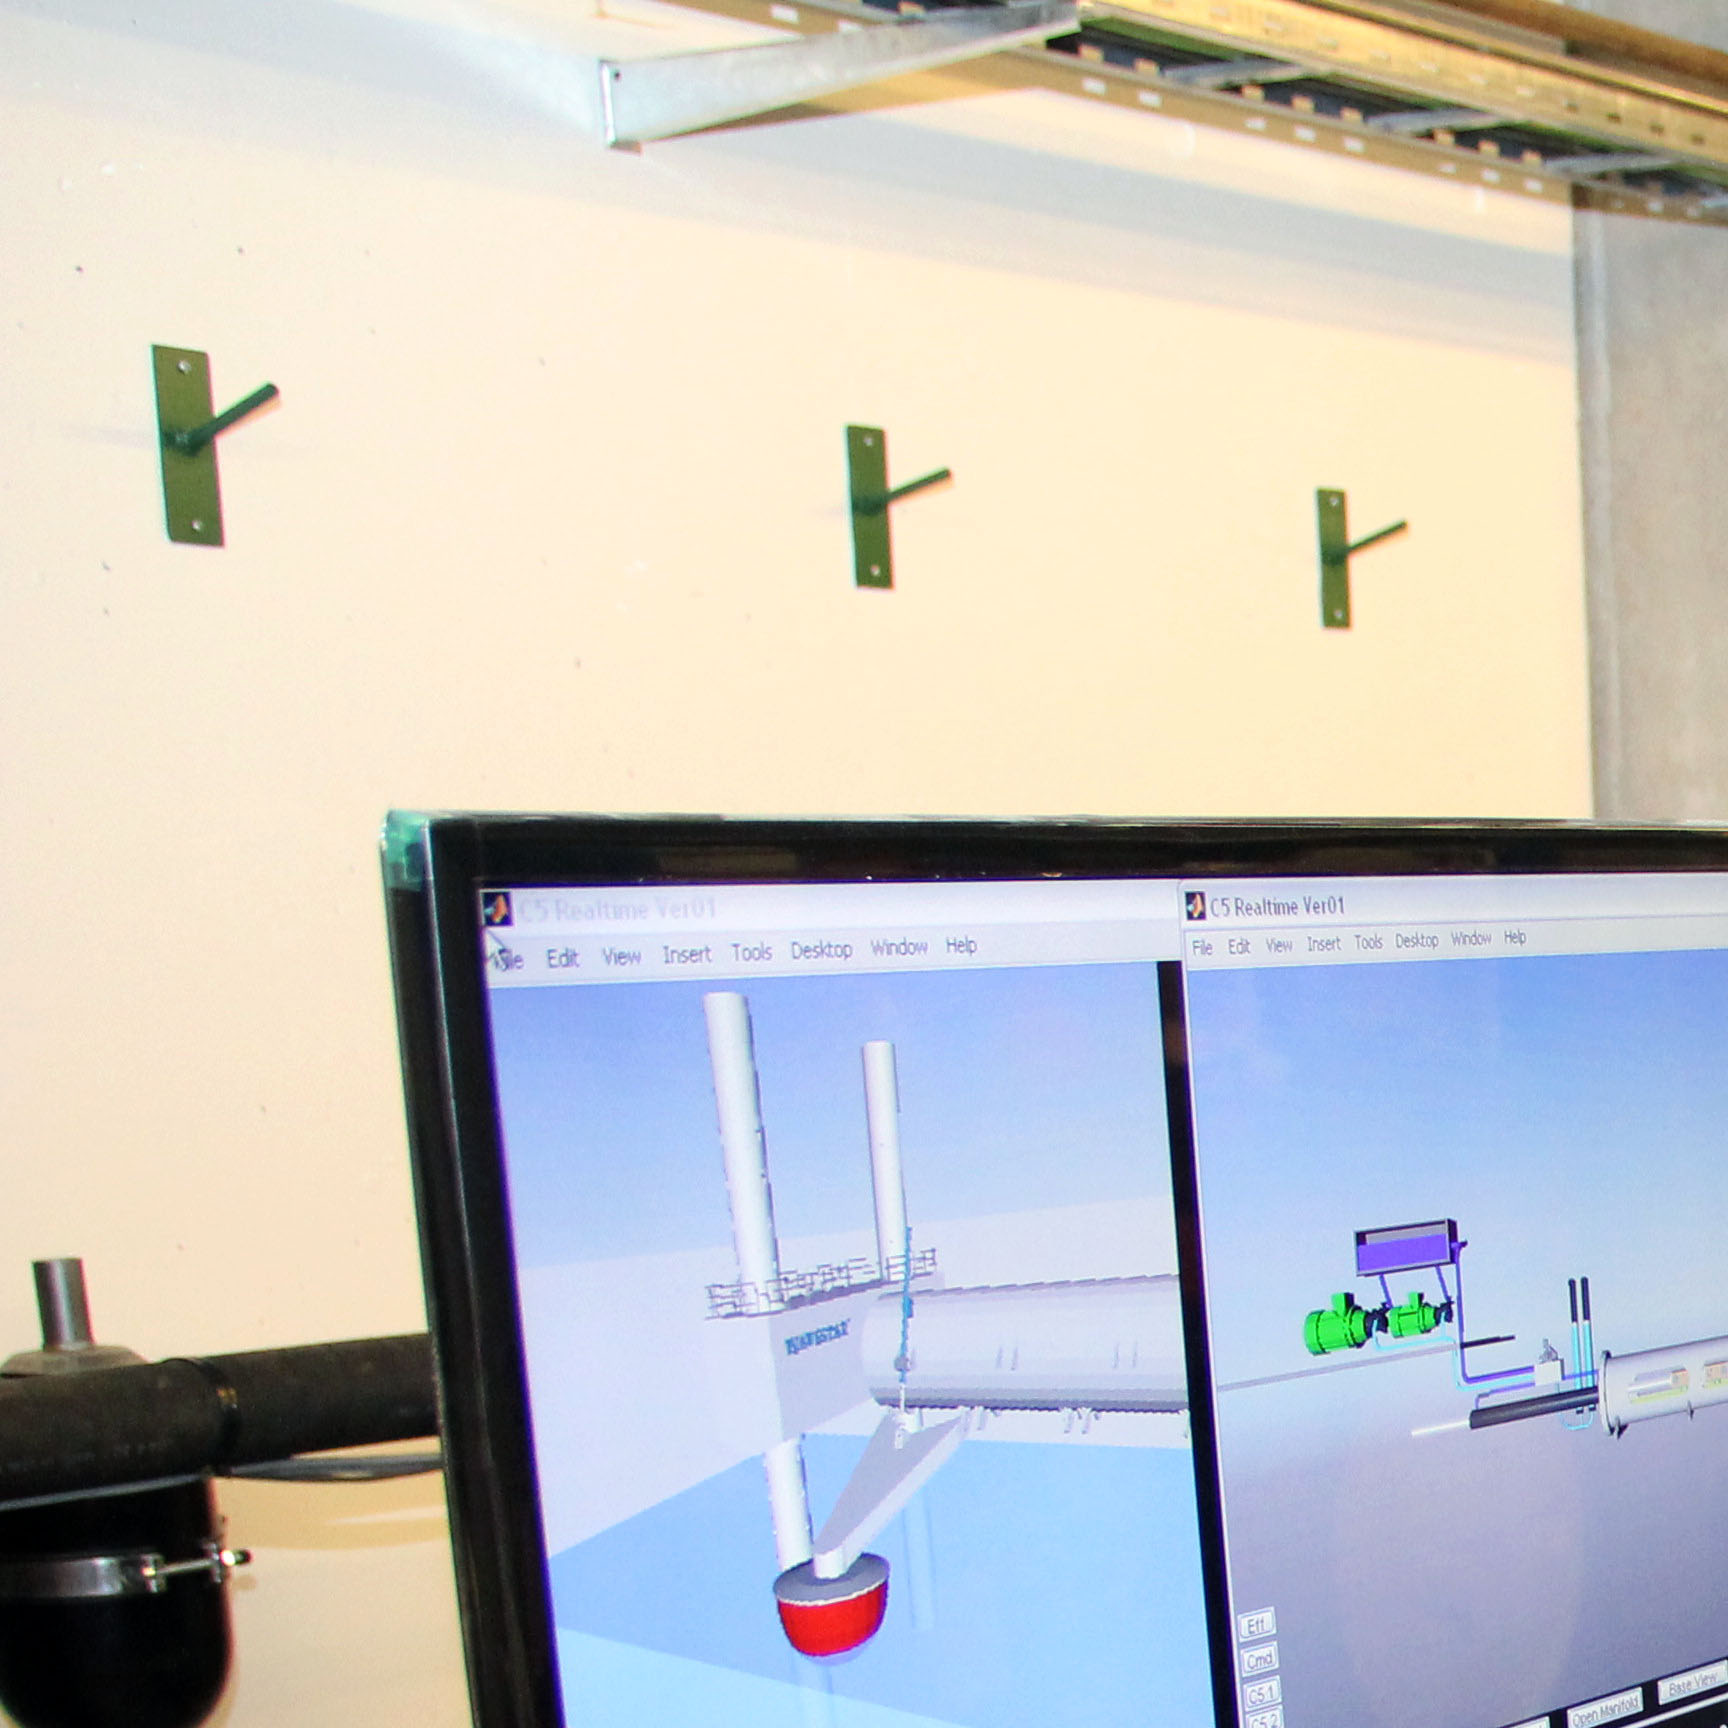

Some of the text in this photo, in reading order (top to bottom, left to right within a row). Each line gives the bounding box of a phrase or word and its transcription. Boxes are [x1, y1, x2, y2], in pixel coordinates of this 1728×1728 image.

[1210, 896, 1345, 917] C5 Realtime Ver01
[547, 947, 580, 968] Edit
[603, 947, 642, 967] View
[663, 945, 712, 965] Insert
[732, 943, 773, 961] Tools
[792, 940, 853, 961] Desktop
[871, 938, 928, 957] Window
[946, 935, 977, 956] Help
[1192, 928, 1527, 956] File Edit View Insert Tools Desktop Window Help
[1247, 1651, 1273, 1670] Cmd
[1249, 1688, 1266, 1705] C5
